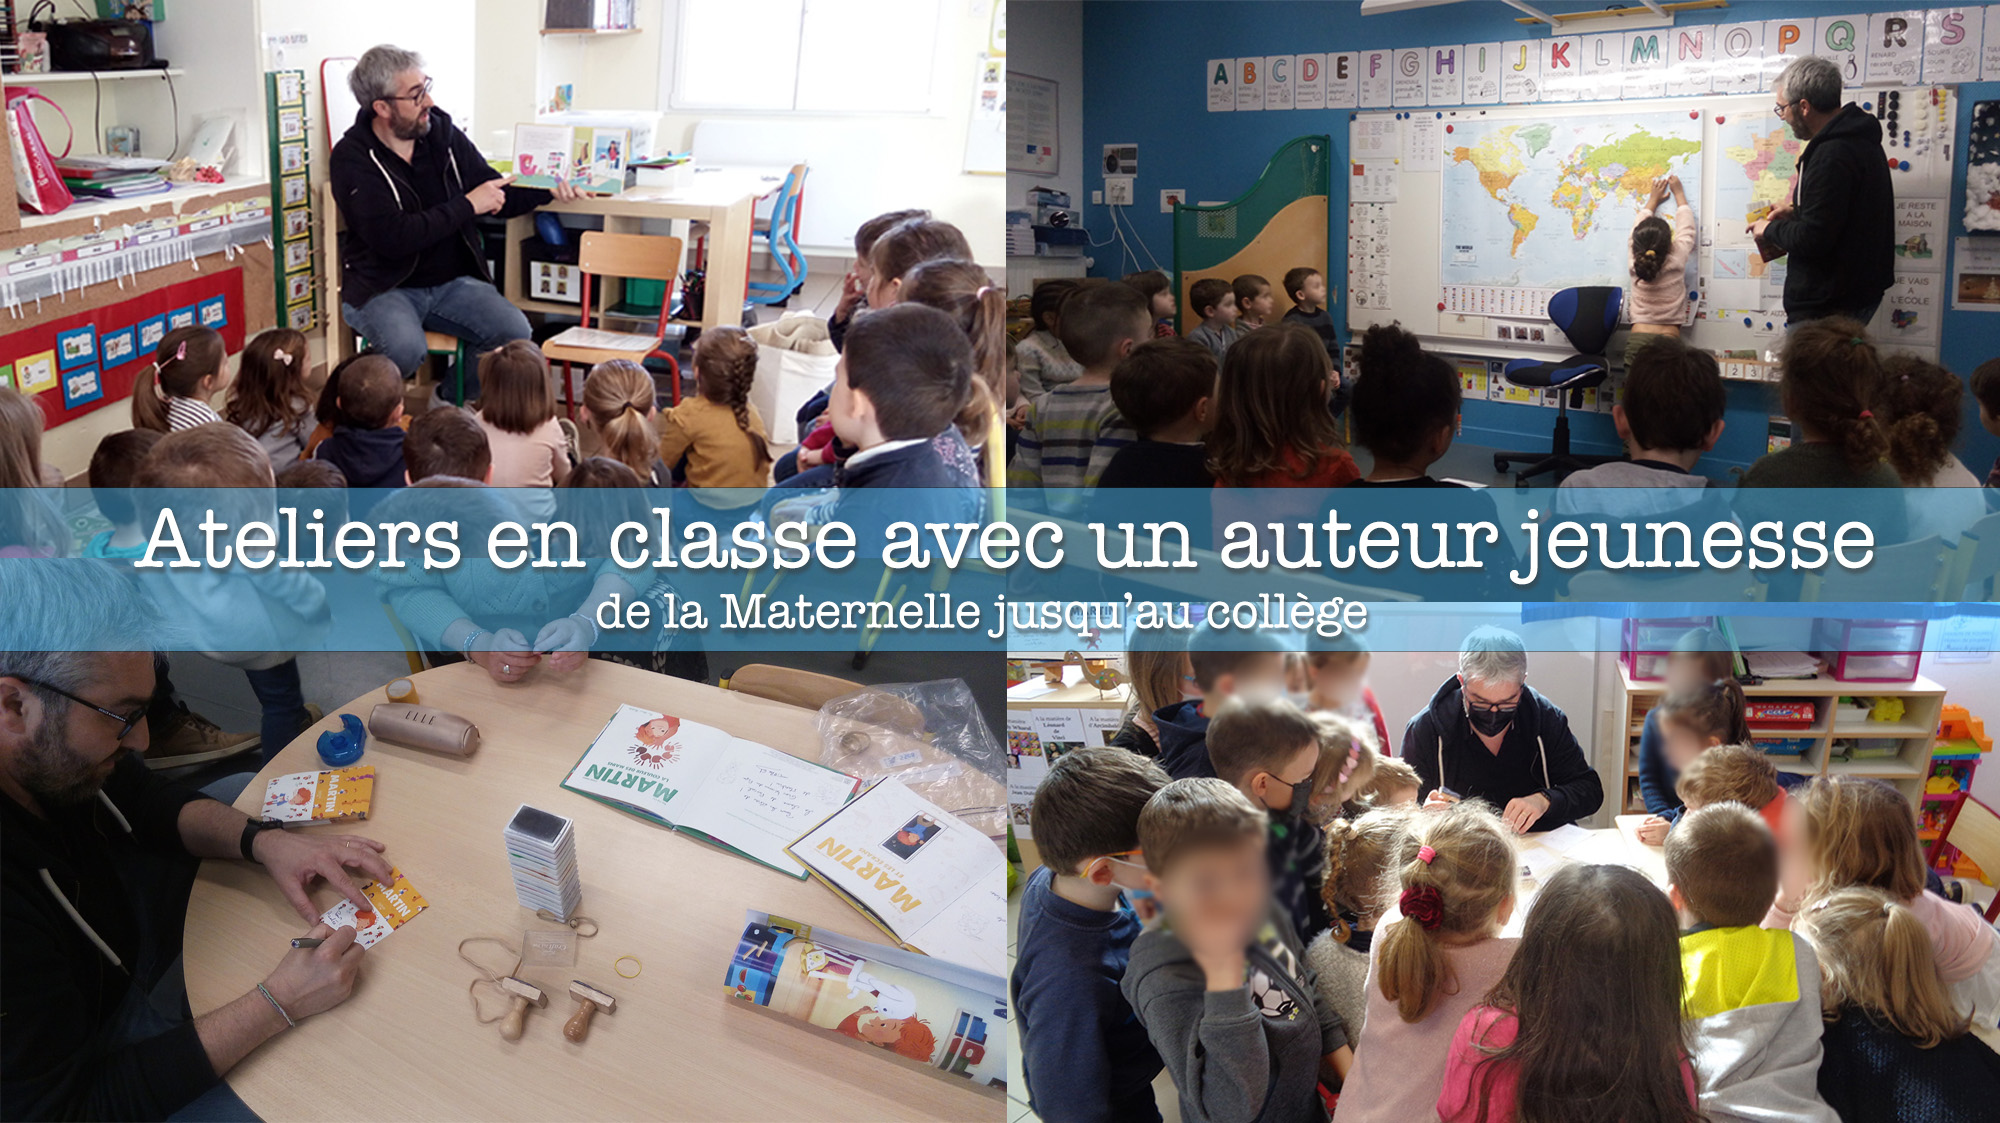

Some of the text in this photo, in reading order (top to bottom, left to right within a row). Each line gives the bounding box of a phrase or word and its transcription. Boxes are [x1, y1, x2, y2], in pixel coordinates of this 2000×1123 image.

[1778, 24, 1800, 54] P
[1825, 20, 1856, 52] Q
[1883, 17, 1908, 48] R
[1941, 12, 1966, 45] S
[1552, 41, 1571, 69] K
[1595, 38, 1610, 66] L
[1631, 35, 1660, 64] M
[1678, 31, 1703, 60] N
[1725, 27, 1753, 58] O
[1870, 51, 1897, 59] RENARD
[1272, 59, 1287, 82] C
[1303, 58, 1319, 82] D
[1337, 56, 1348, 79] E
[1370, 53, 1382, 78] F
[1400, 51, 1420, 77] G
[1436, 49, 1454, 75] H
[1513, 44, 1527, 71] J
[1214, 62, 1228, 85] A
[1243, 62, 1256, 84] B
[1896, 202, 1937, 210] JE RESTE
[1898, 220, 1932, 228] MAISON
[1908, 277, 1929, 285] VAIS
[1732, 367, 1738, 376] 2
[1750, 369, 1757, 377] 3
[607, 761, 626, 770] MAINS
[636, 768, 661, 780] COULEUR
[325, 774, 340, 813] MARTIN
[584, 763, 679, 803] MARTIN
[816, 836, 923, 913] MARTIN
[376, 881, 412, 918] MARTIN
